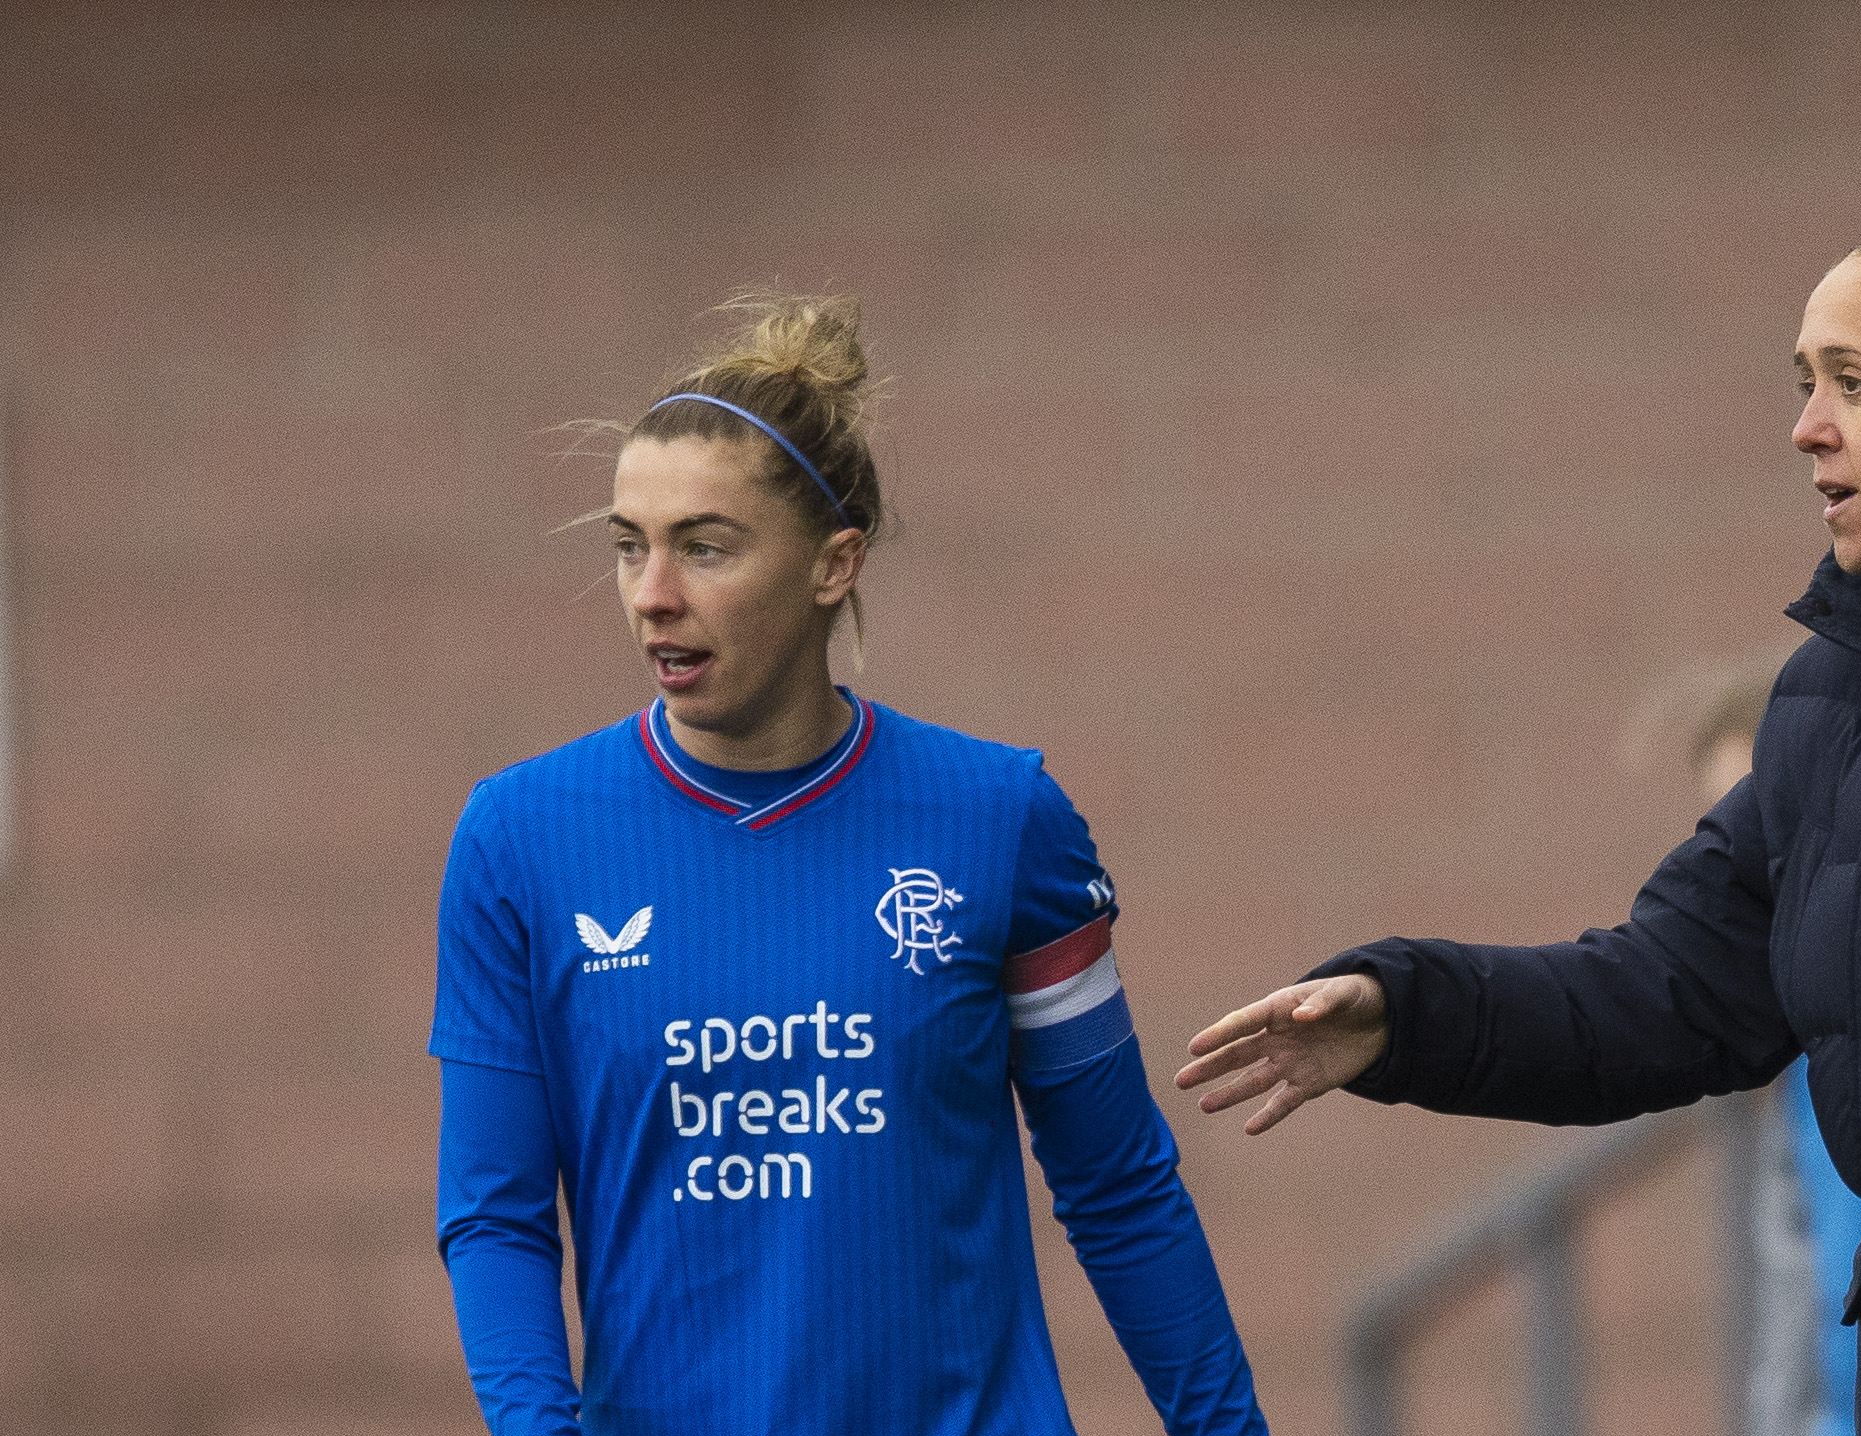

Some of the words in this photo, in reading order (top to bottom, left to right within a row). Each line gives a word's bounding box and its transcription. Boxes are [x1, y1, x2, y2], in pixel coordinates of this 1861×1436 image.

[583, 954, 650, 973] CASTORE
[665, 1001, 874, 1072] sports
[670, 1076, 886, 1136] breaks
[673, 1153, 812, 1202] .com
